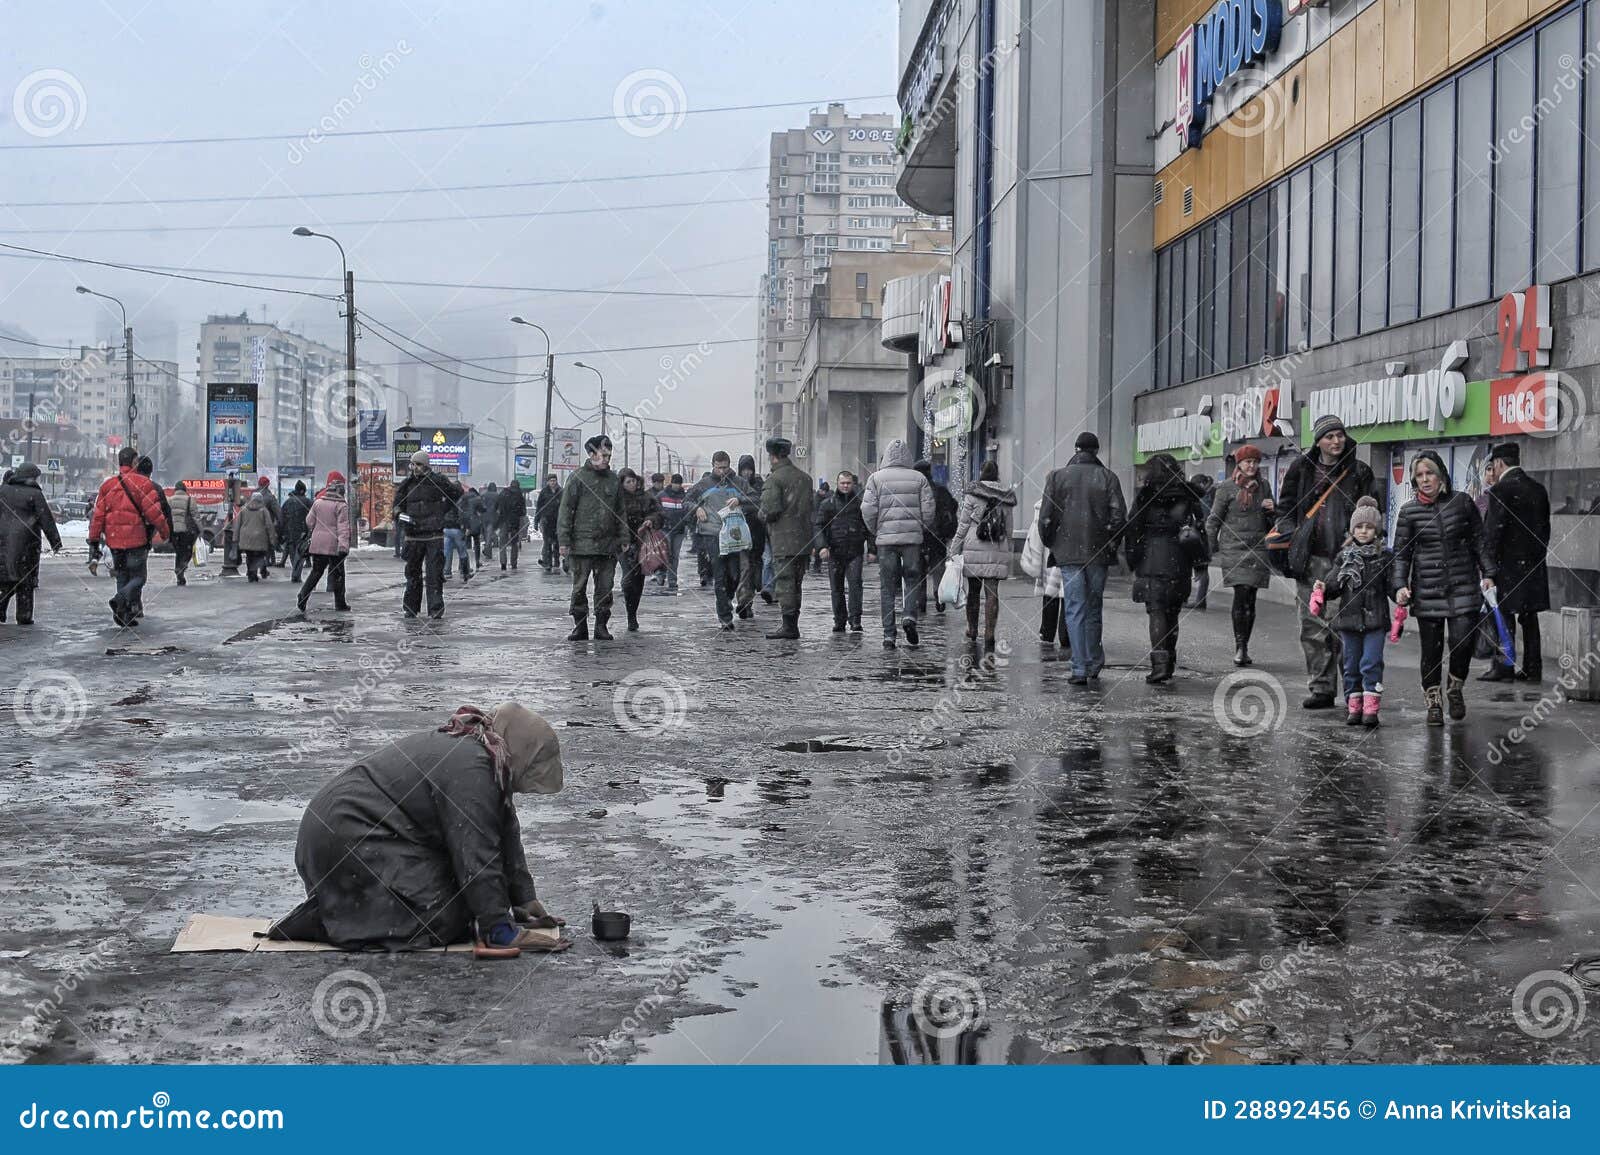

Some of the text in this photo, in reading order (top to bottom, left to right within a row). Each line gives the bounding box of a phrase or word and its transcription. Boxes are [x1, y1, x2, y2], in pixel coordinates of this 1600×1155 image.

[1197, 0, 1268, 104] MODIS
[1498, 285, 1548, 373] 24
[1498, 390, 1535, 425] часа
[432, 445, 466, 453] РОССИИ
